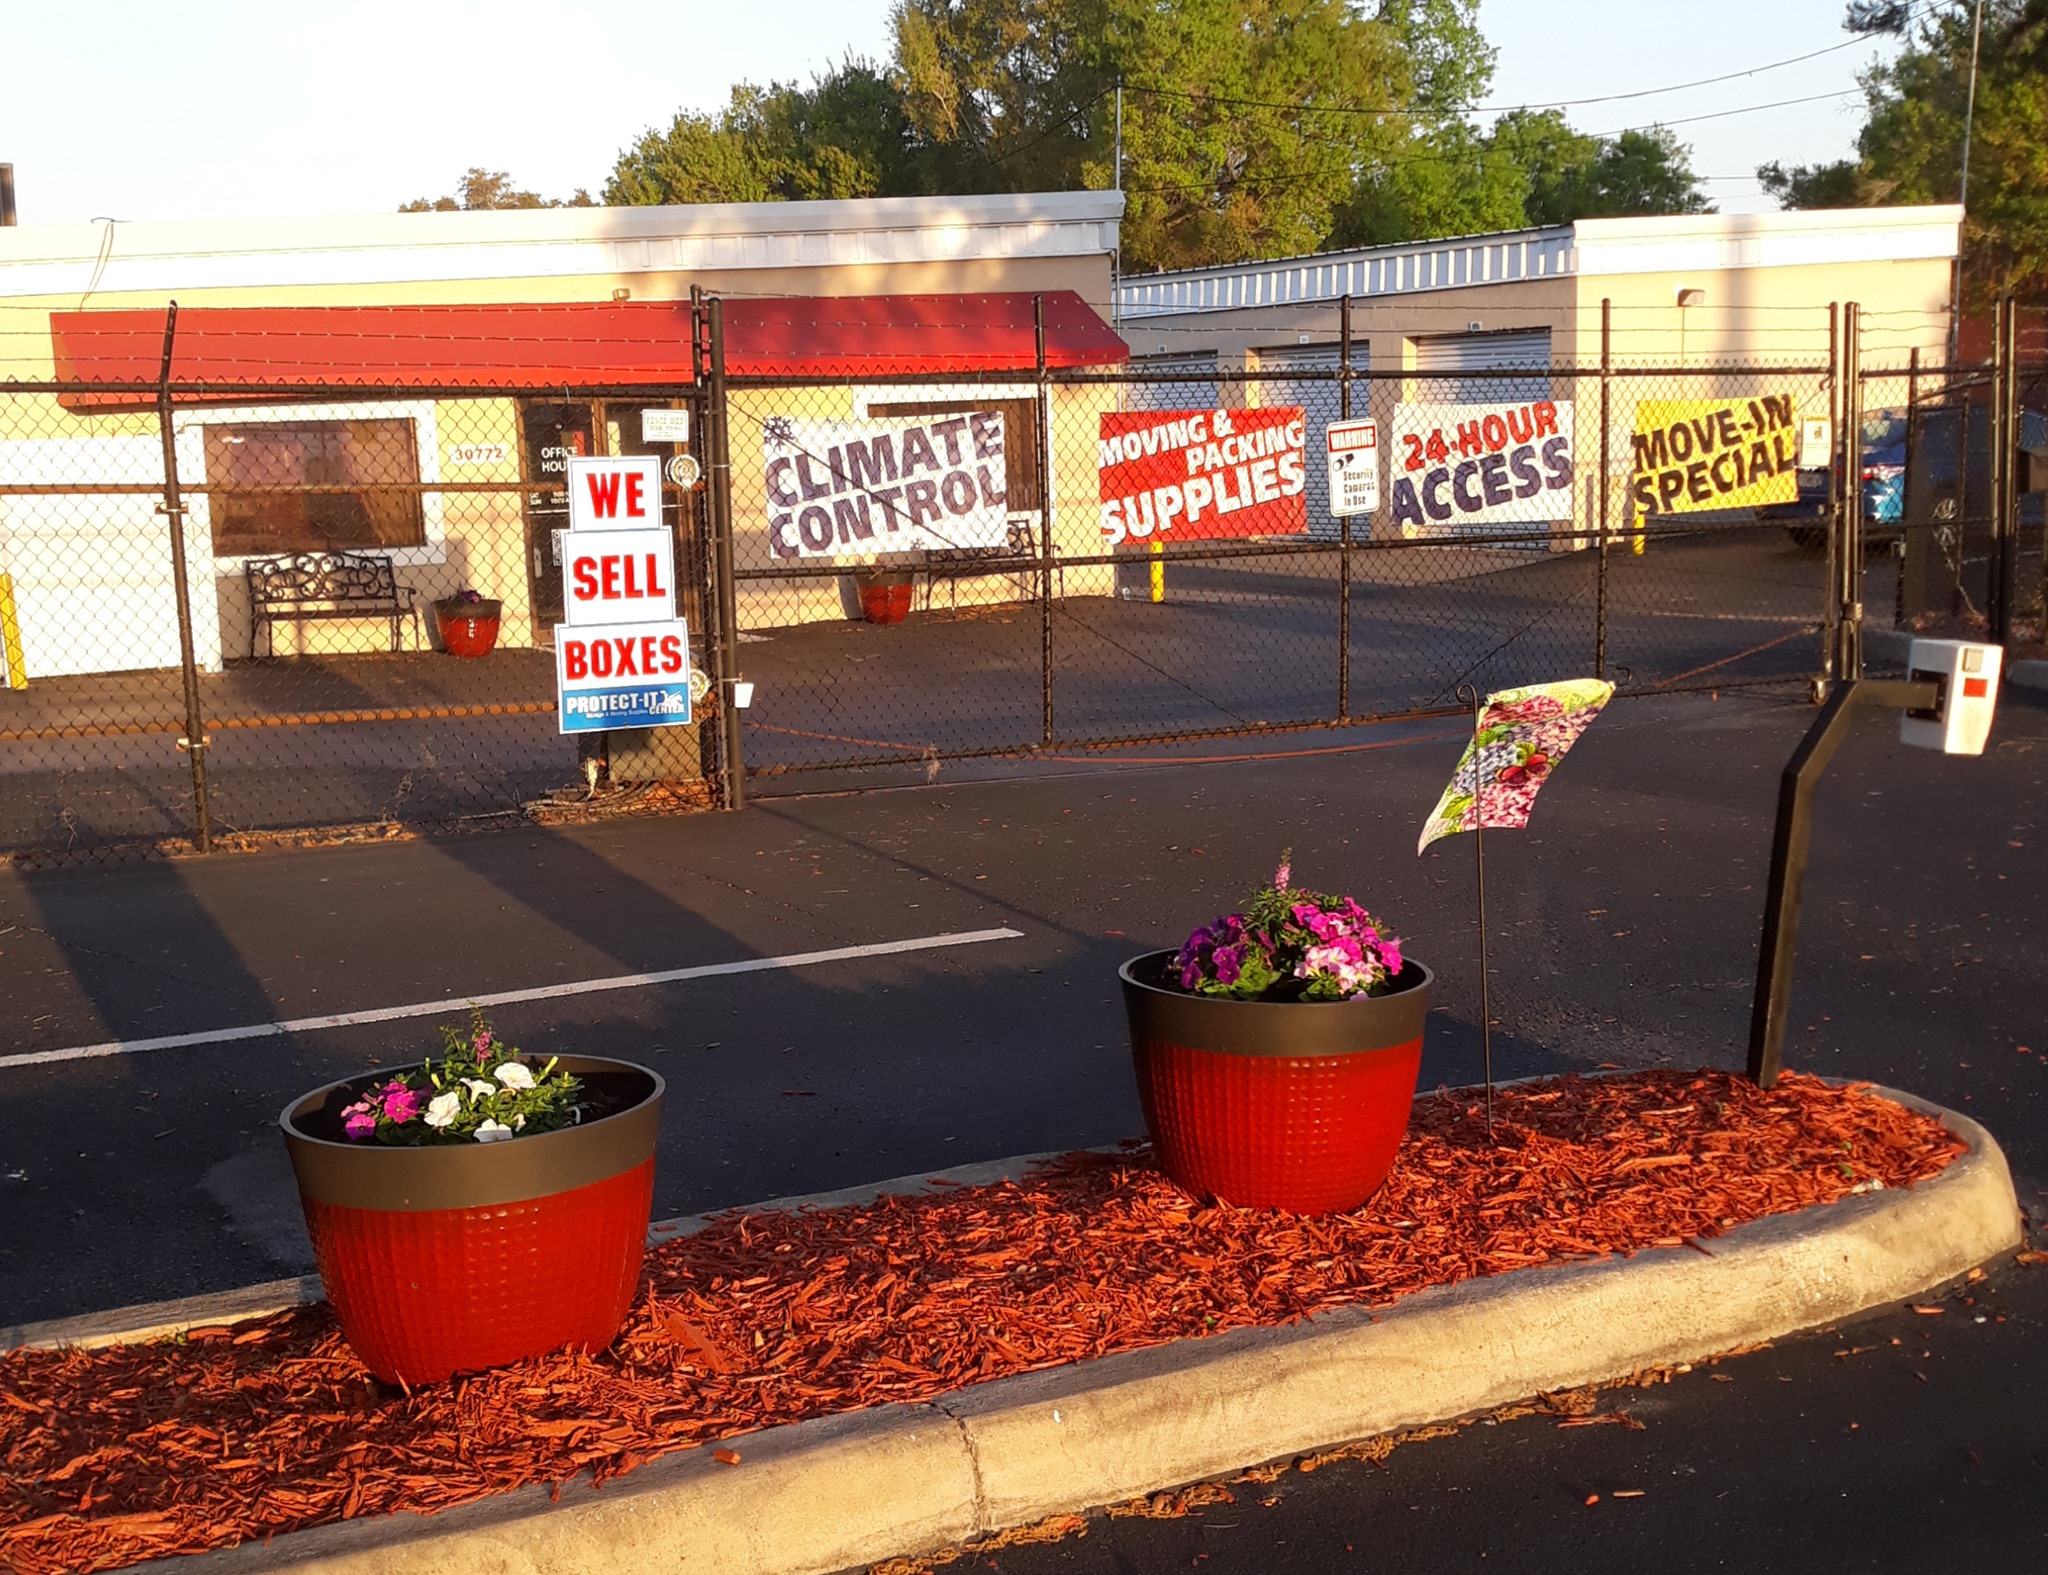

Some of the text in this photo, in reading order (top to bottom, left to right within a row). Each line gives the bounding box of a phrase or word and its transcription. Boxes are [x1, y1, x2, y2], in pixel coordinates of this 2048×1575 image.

[455, 448, 504, 461] 30772
[541, 447, 578, 458] OFFICE
[1098, 409, 1236, 468] MOVING &
[1185, 420, 1305, 476] PACKING
[1330, 427, 1375, 450] WARNING
[1403, 401, 1559, 472] 24-HOUR
[1631, 393, 1793, 474] MOVE-IN
[542, 461, 567, 472] HOU
[766, 411, 1003, 508] CLIMATE
[1343, 468, 1374, 482] Security
[1392, 436, 1574, 526] ACCESS
[1634, 435, 1800, 515] SPECIAL
[586, 472, 646, 519] WE
[770, 464, 1006, 559] CONTROL
[1100, 451, 1305, 545] SUPPLIES
[1344, 482, 1375, 494] Cameras
[573, 553, 666, 602] SELL
[564, 635, 683, 680] BOXES
[566, 691, 659, 714] PROTECT-IT
[649, 703, 685, 715] CENTER
